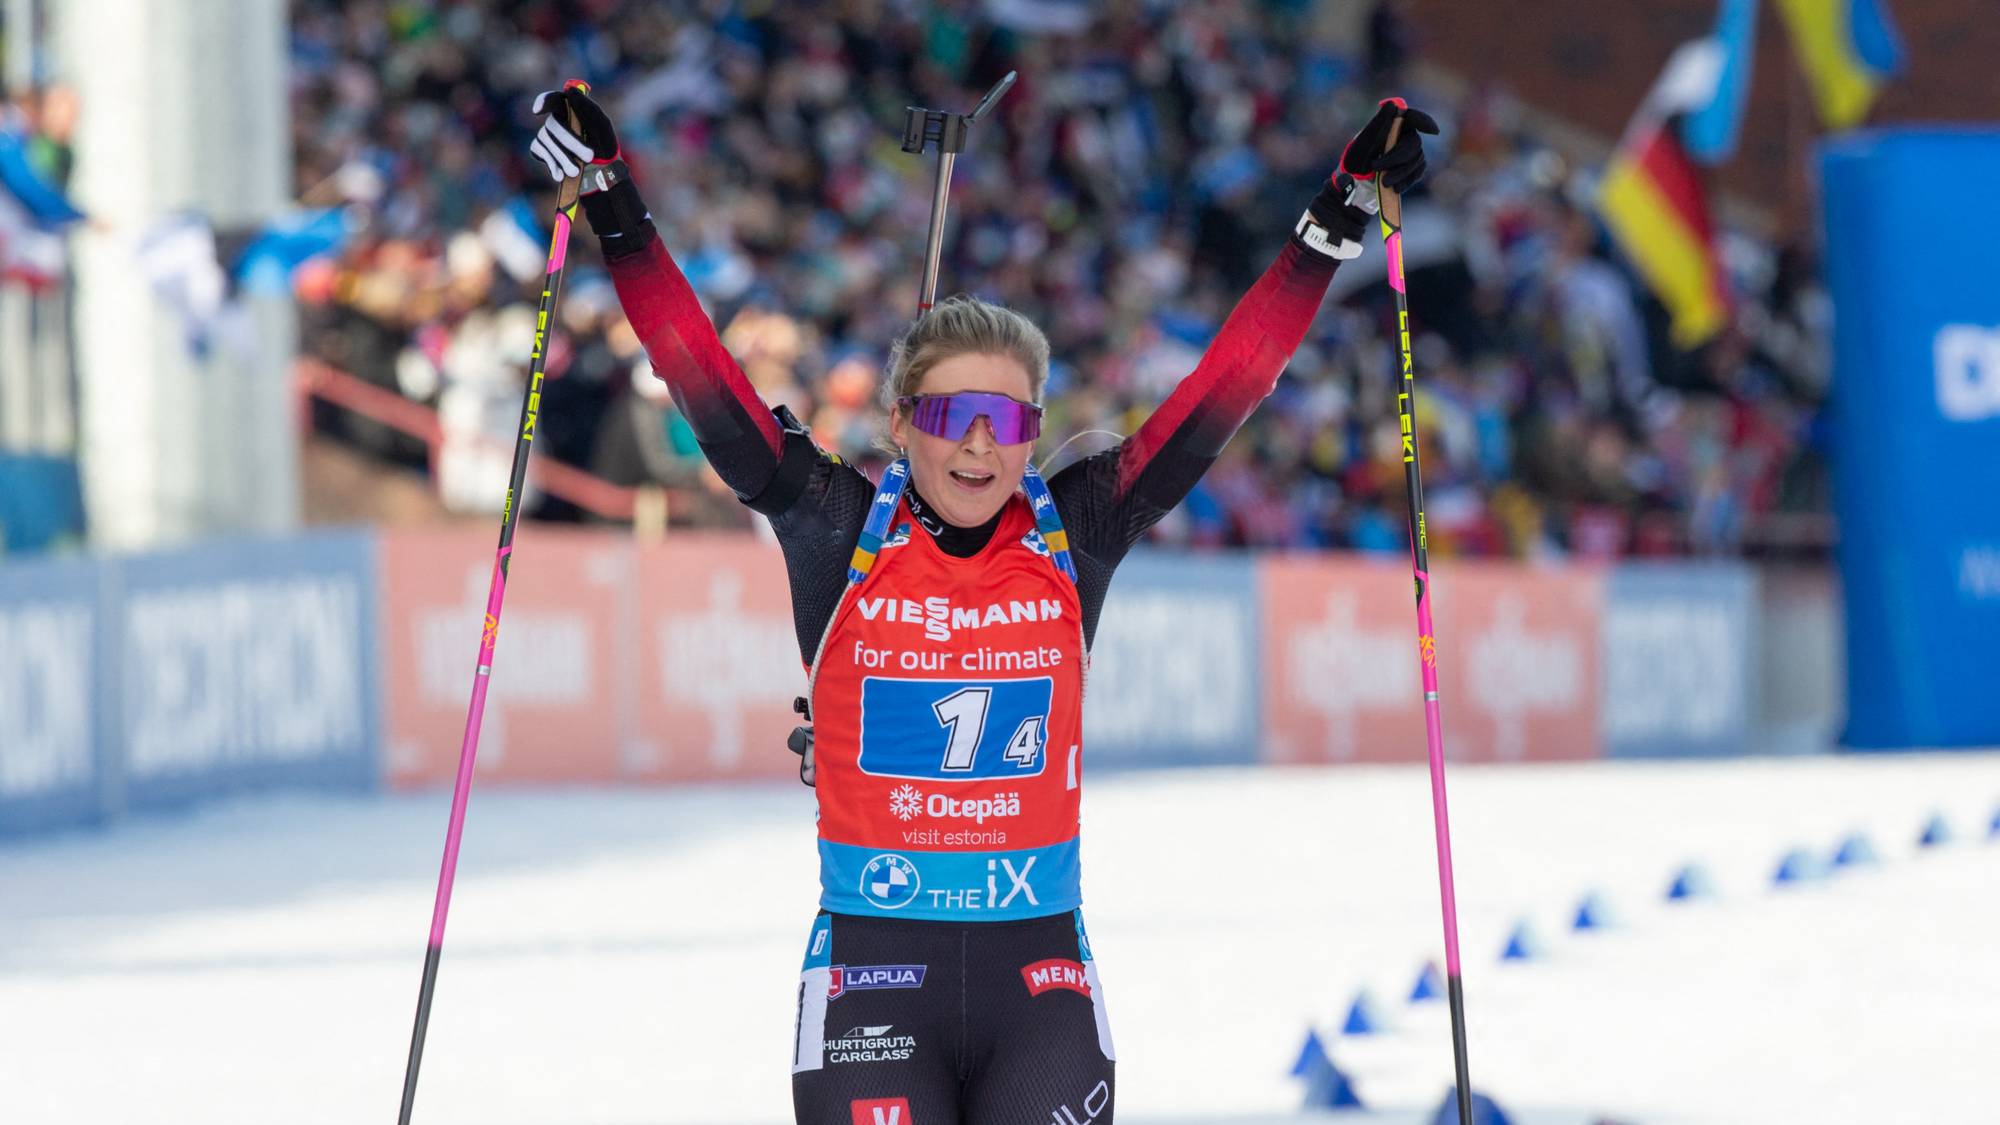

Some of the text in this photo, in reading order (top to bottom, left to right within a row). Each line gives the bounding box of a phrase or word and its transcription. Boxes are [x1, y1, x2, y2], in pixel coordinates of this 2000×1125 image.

[1398, 310, 1414, 462] LEKI LEKI
[523, 372, 545, 440] LEKI
[854, 641, 1063, 671] for our climate
[927, 792, 1020, 824] Otepää
[903, 829, 1006, 845] visit estonia
[868, 856, 912, 874] BMW
[927, 856, 1039, 909] THE iX
[847, 969, 918, 985] LAPUA
[823, 1036, 916, 1050] HURTIGRUTA
